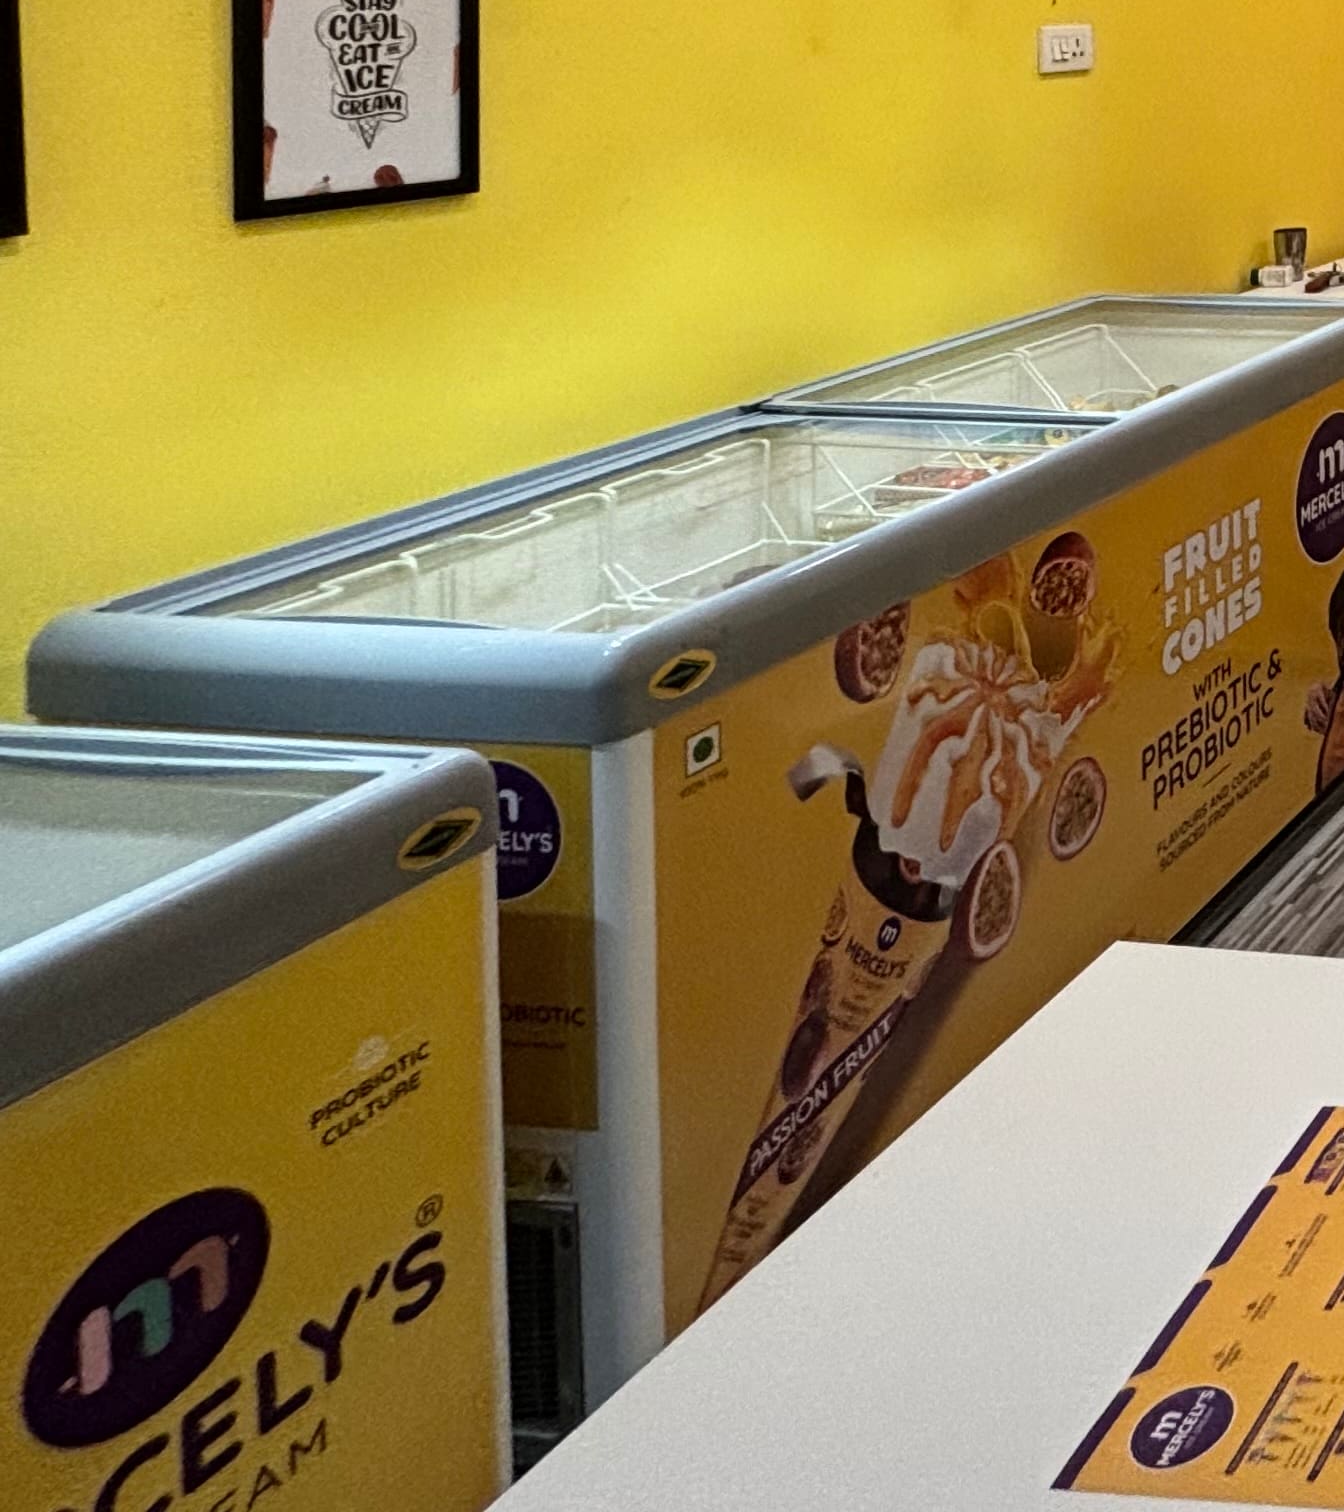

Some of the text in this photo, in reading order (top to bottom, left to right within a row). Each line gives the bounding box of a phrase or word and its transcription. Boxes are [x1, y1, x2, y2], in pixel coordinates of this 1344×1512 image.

[329, 13, 405, 41] COOL
[338, 43, 381, 66] EAT
[338, 94, 401, 116] CREAM
[344, 65, 395, 92] ICE
[1163, 497, 1263, 594] FRUIT
[1163, 542, 1263, 628] FILLED
[1161, 576, 1263, 676] CONES
[1142, 648, 1283, 782] PREBIOTIC &
[1193, 656, 1233, 700] WITH
[1153, 687, 1275, 811] PROBIOTIC
[499, 831, 553, 853] ELY'S
[309, 1040, 431, 1130] PROBIOTIC
[321, 1070, 422, 1146] CULTURE
[751, 1080, 829, 1177] PASSION
[833, 1013, 892, 1087] FRUIT
[1156, 1389, 1216, 1466] MERCELY'S
